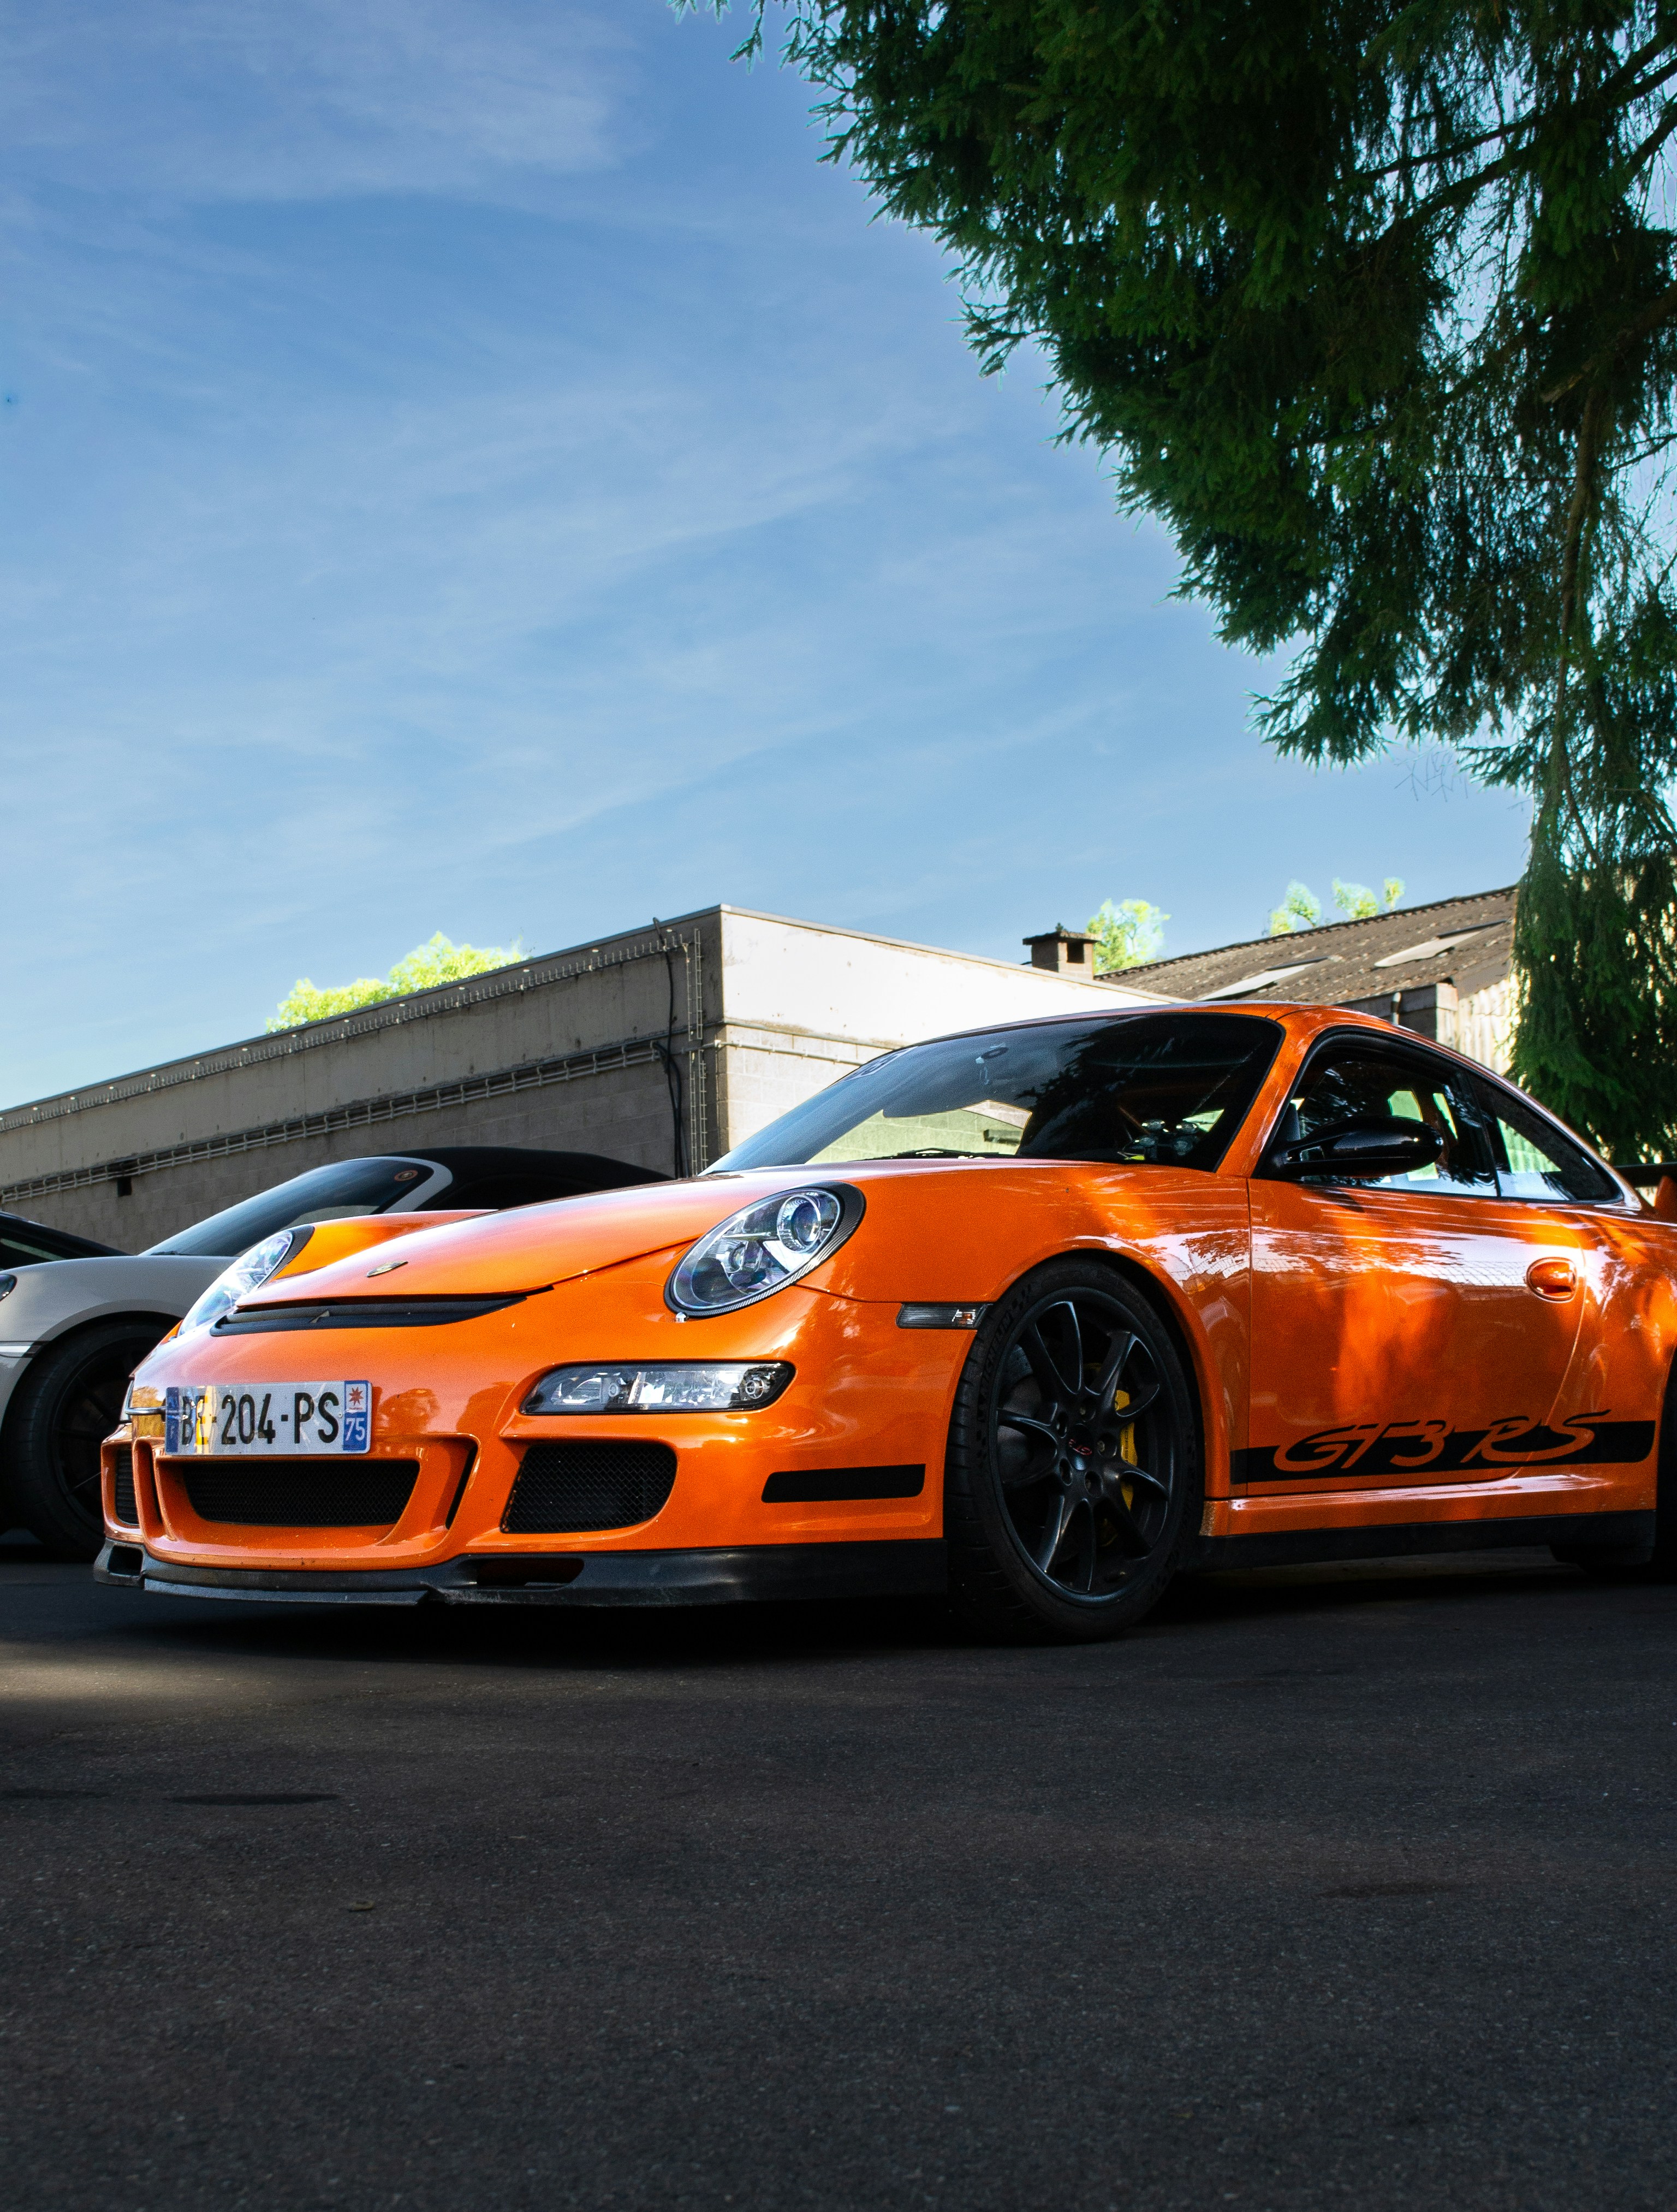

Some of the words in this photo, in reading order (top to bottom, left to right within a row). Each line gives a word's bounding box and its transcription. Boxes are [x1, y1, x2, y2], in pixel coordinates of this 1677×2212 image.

[346, 1418, 366, 1442] 75
[1273, 1420, 1455, 1472] GT3
[1460, 1409, 1611, 1463] RS
